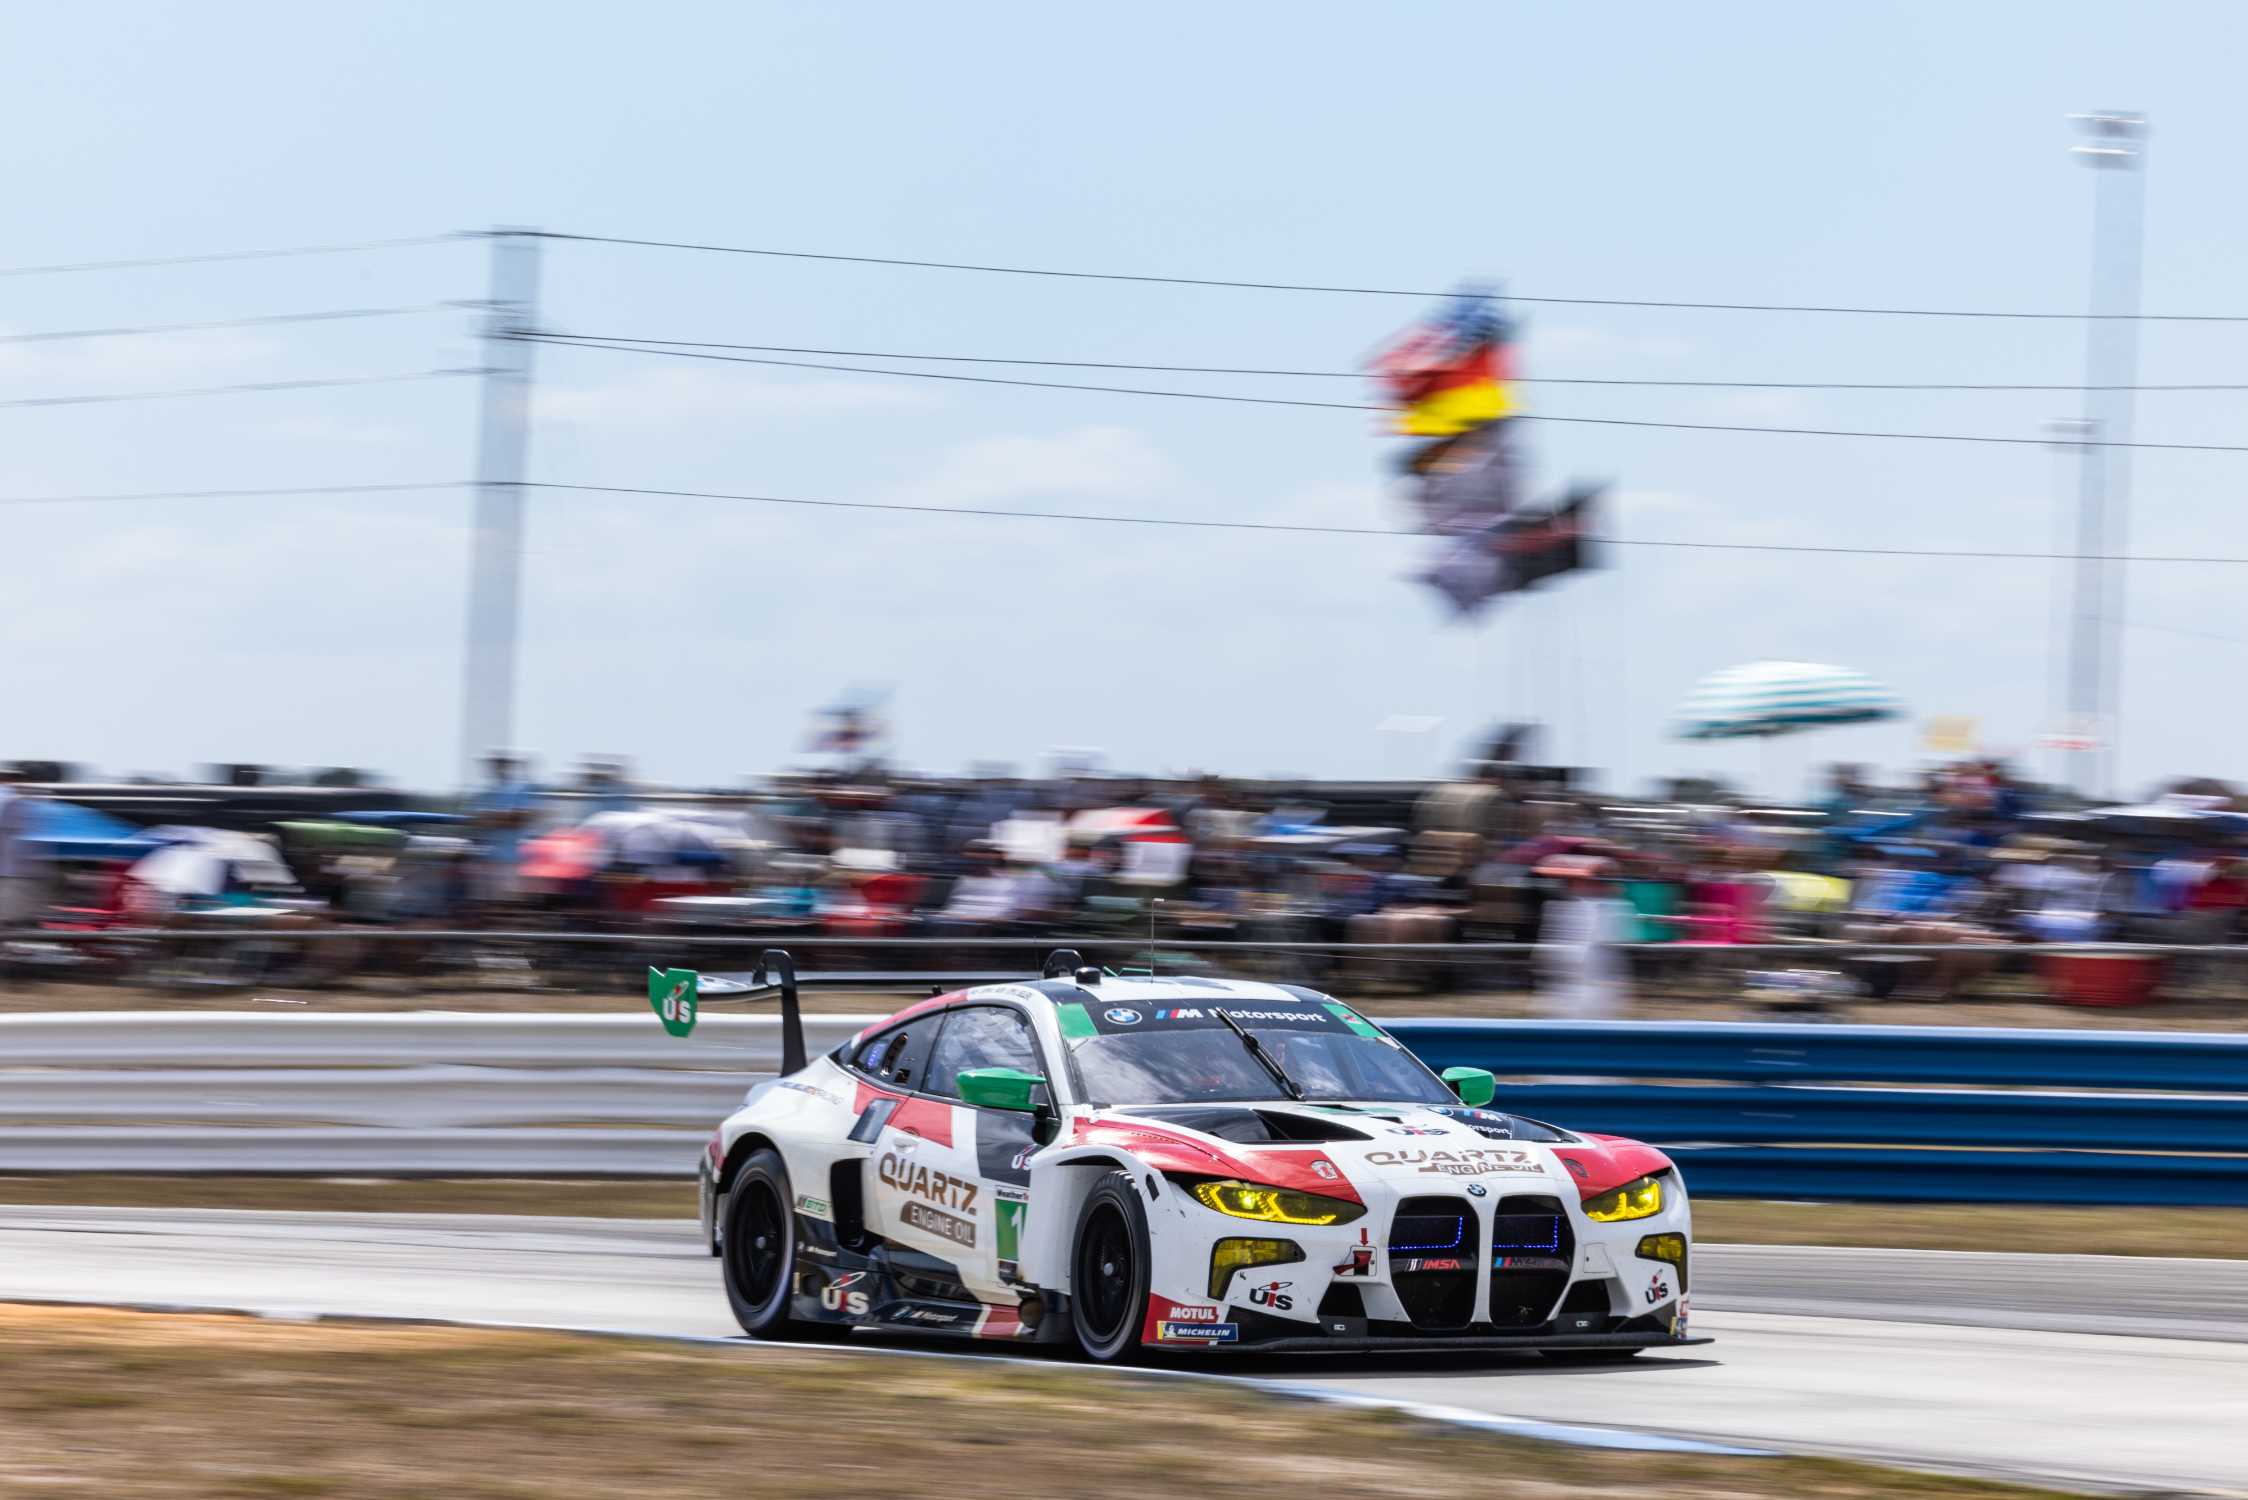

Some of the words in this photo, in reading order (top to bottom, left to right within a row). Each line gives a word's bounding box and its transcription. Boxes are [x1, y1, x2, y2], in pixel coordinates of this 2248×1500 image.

[1363, 1149, 1532, 1166] QUARTZ
[879, 1151, 978, 1217] QUARTZ
[910, 1205, 953, 1236] ENGINE
[954, 1221, 975, 1244] OIL
[1011, 1205, 1026, 1260] 1
[1422, 1258, 1461, 1271] IMSA
[1169, 1306, 1216, 1320] MOTUL
[1177, 1327, 1231, 1337] MICHELIN
